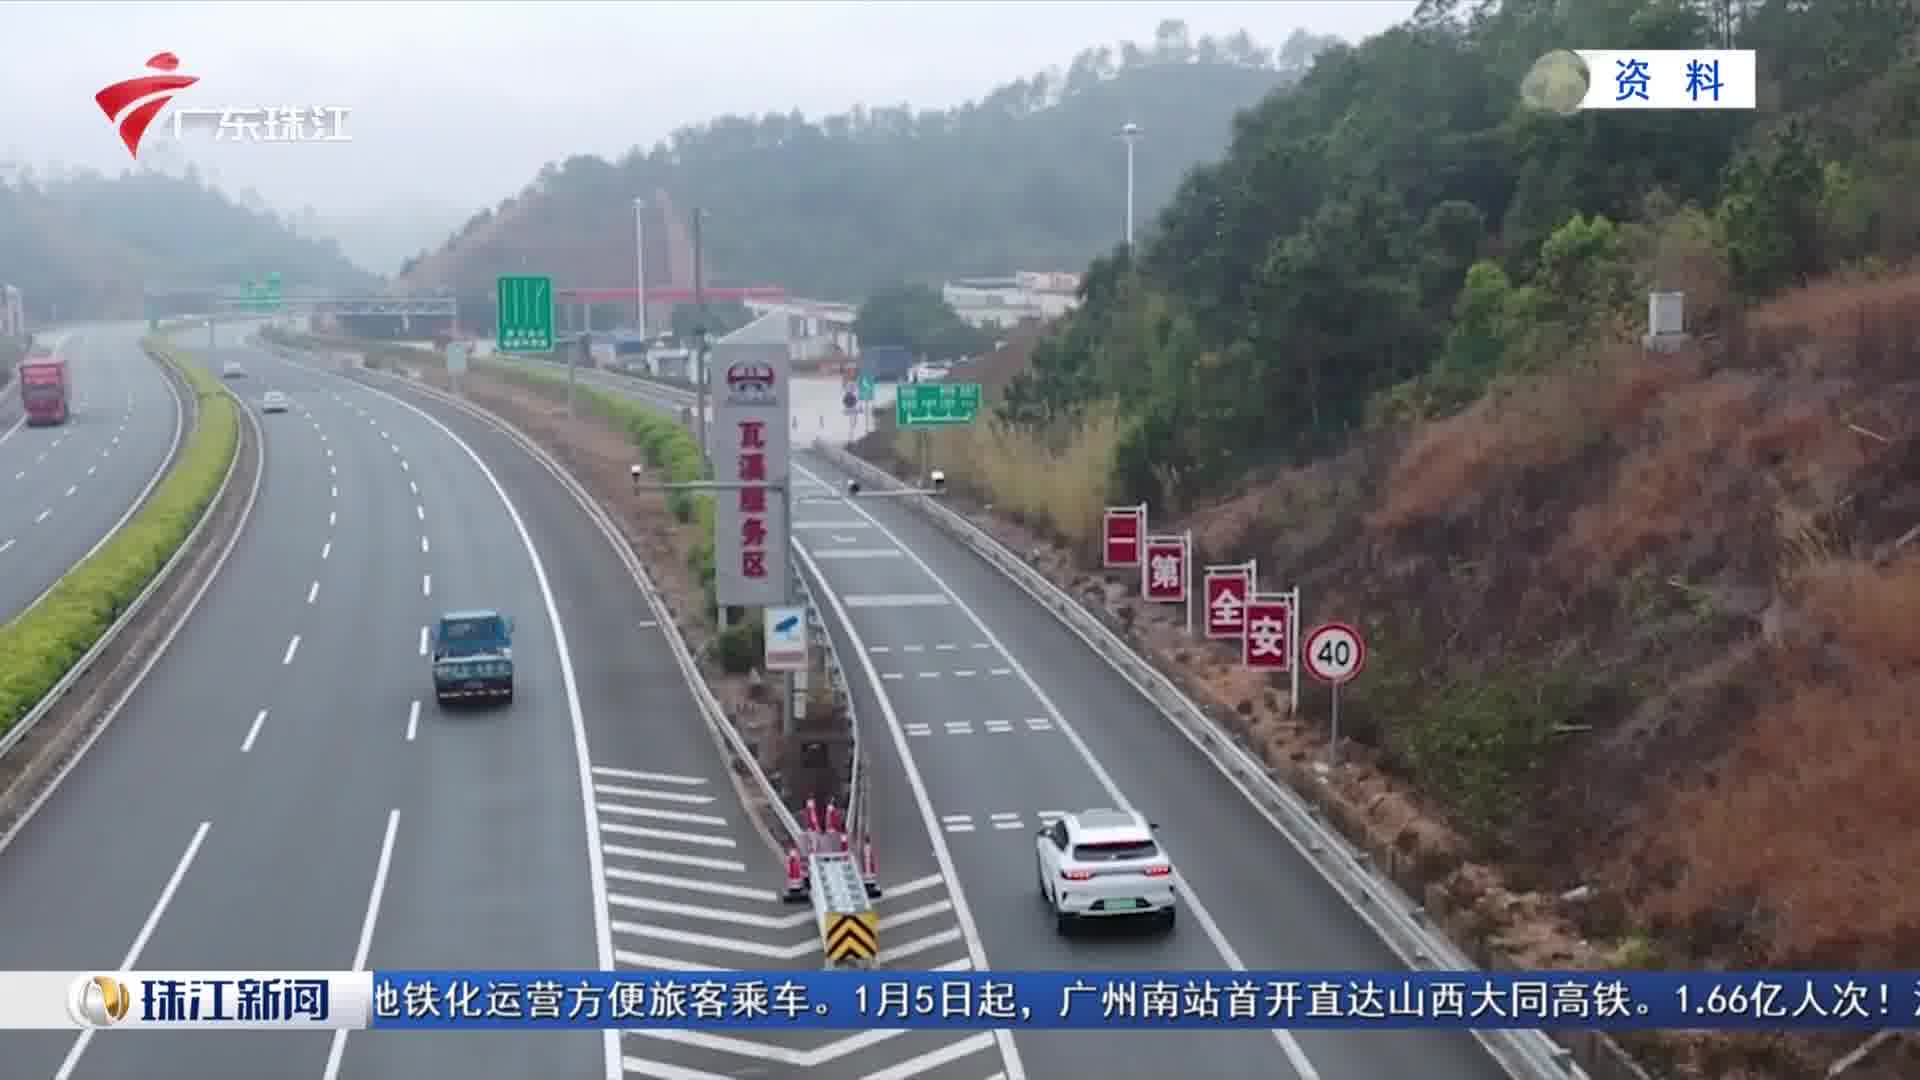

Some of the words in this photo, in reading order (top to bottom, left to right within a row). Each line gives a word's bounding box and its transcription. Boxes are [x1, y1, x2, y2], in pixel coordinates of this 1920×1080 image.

[1151, 555, 1181, 589] 第
[1211, 589, 1243, 627] 全
[1250, 616, 1284, 656] 安
[1317, 639, 1350, 668] 40
